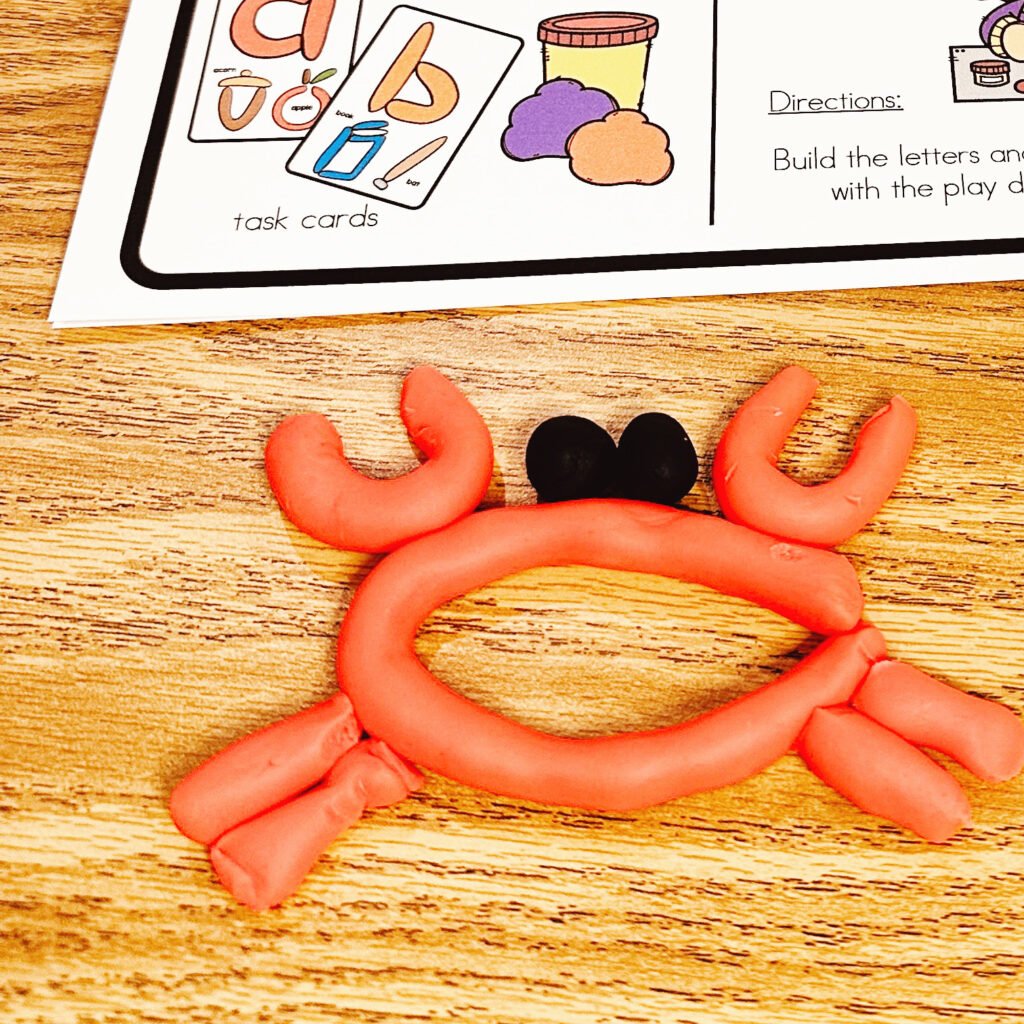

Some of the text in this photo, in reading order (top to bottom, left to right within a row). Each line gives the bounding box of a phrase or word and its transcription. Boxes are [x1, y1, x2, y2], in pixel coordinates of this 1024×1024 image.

[767, 89, 905, 116] Directions:
[773, 145, 836, 172] Build
[845, 144, 889, 169] the
[898, 143, 981, 167] letters
[830, 176, 880, 201] with
[890, 174, 934, 199] the
[943, 172, 998, 207] play
[233, 203, 379, 232] task cards
